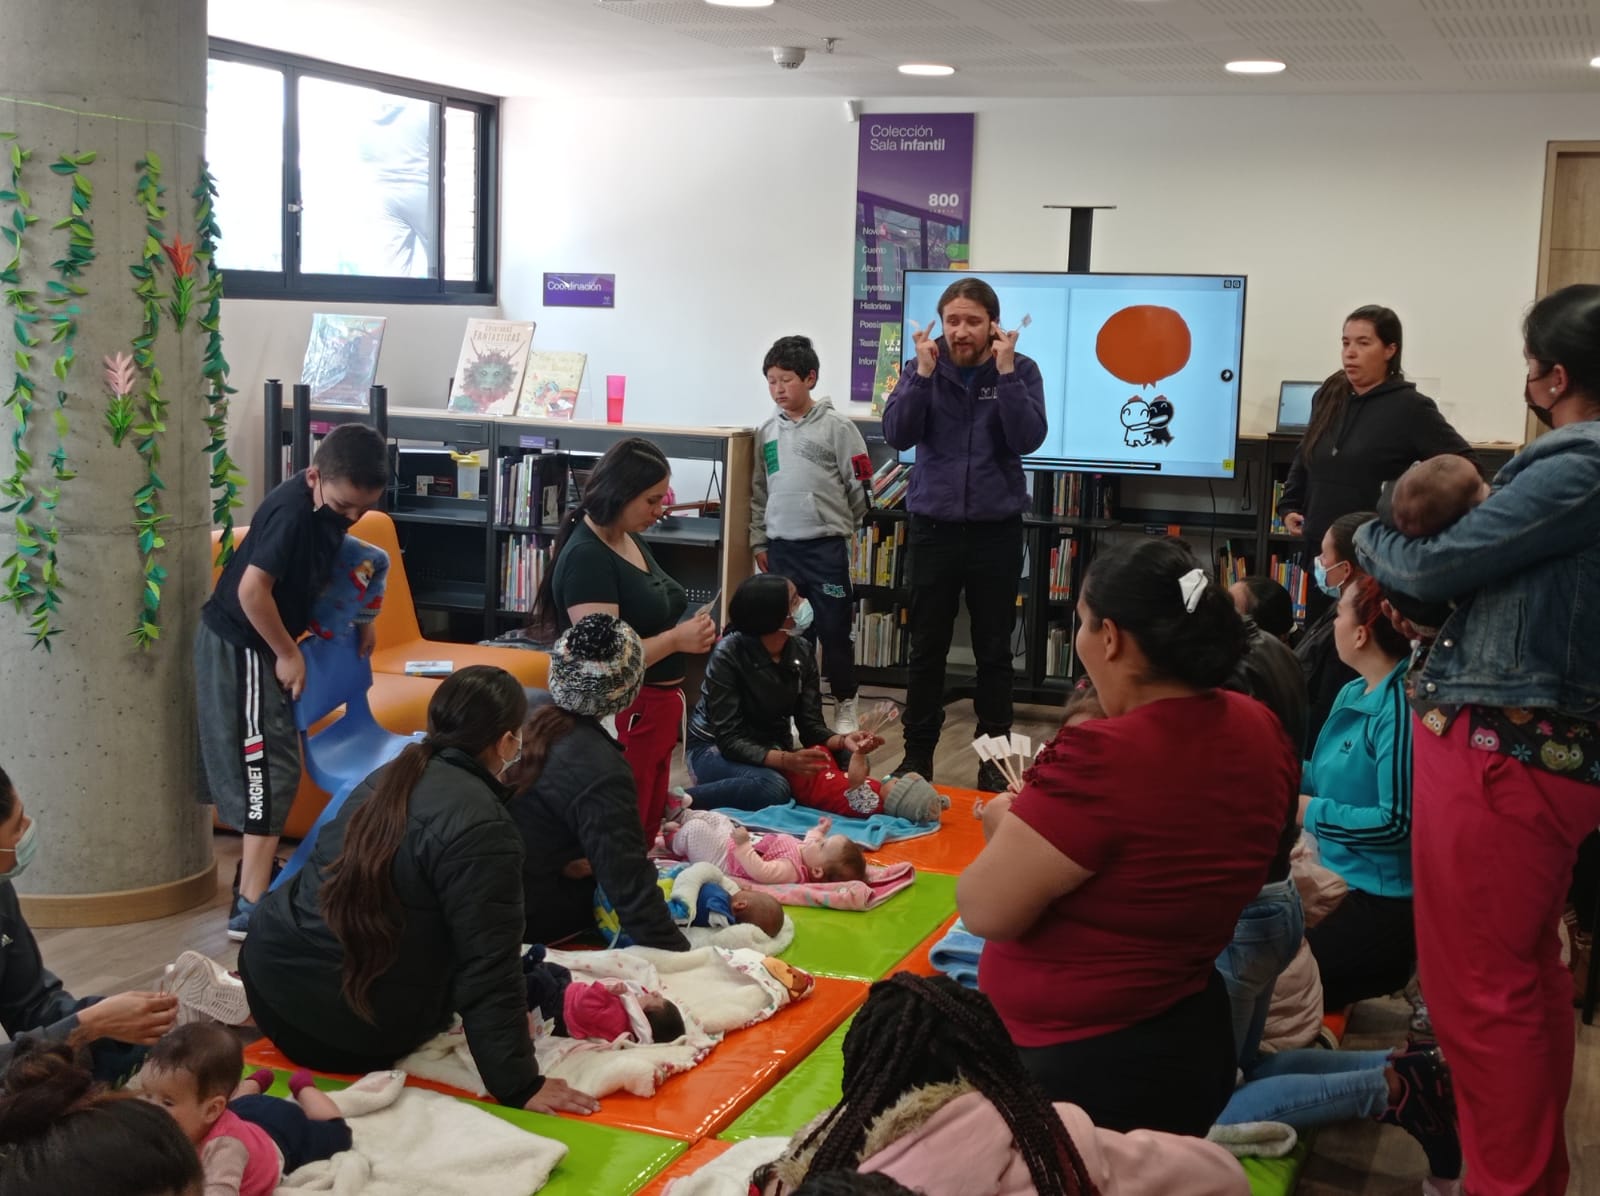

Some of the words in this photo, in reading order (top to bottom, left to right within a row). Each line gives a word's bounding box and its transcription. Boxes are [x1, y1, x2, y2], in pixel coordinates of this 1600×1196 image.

[870, 124, 933, 138] Colección
[870, 138, 897, 152] Sala
[900, 138, 945, 151] infantil
[928, 193, 959, 207] 800
[860, 301, 892, 310] Historieta
[248, 765, 263, 820] SARGNET
